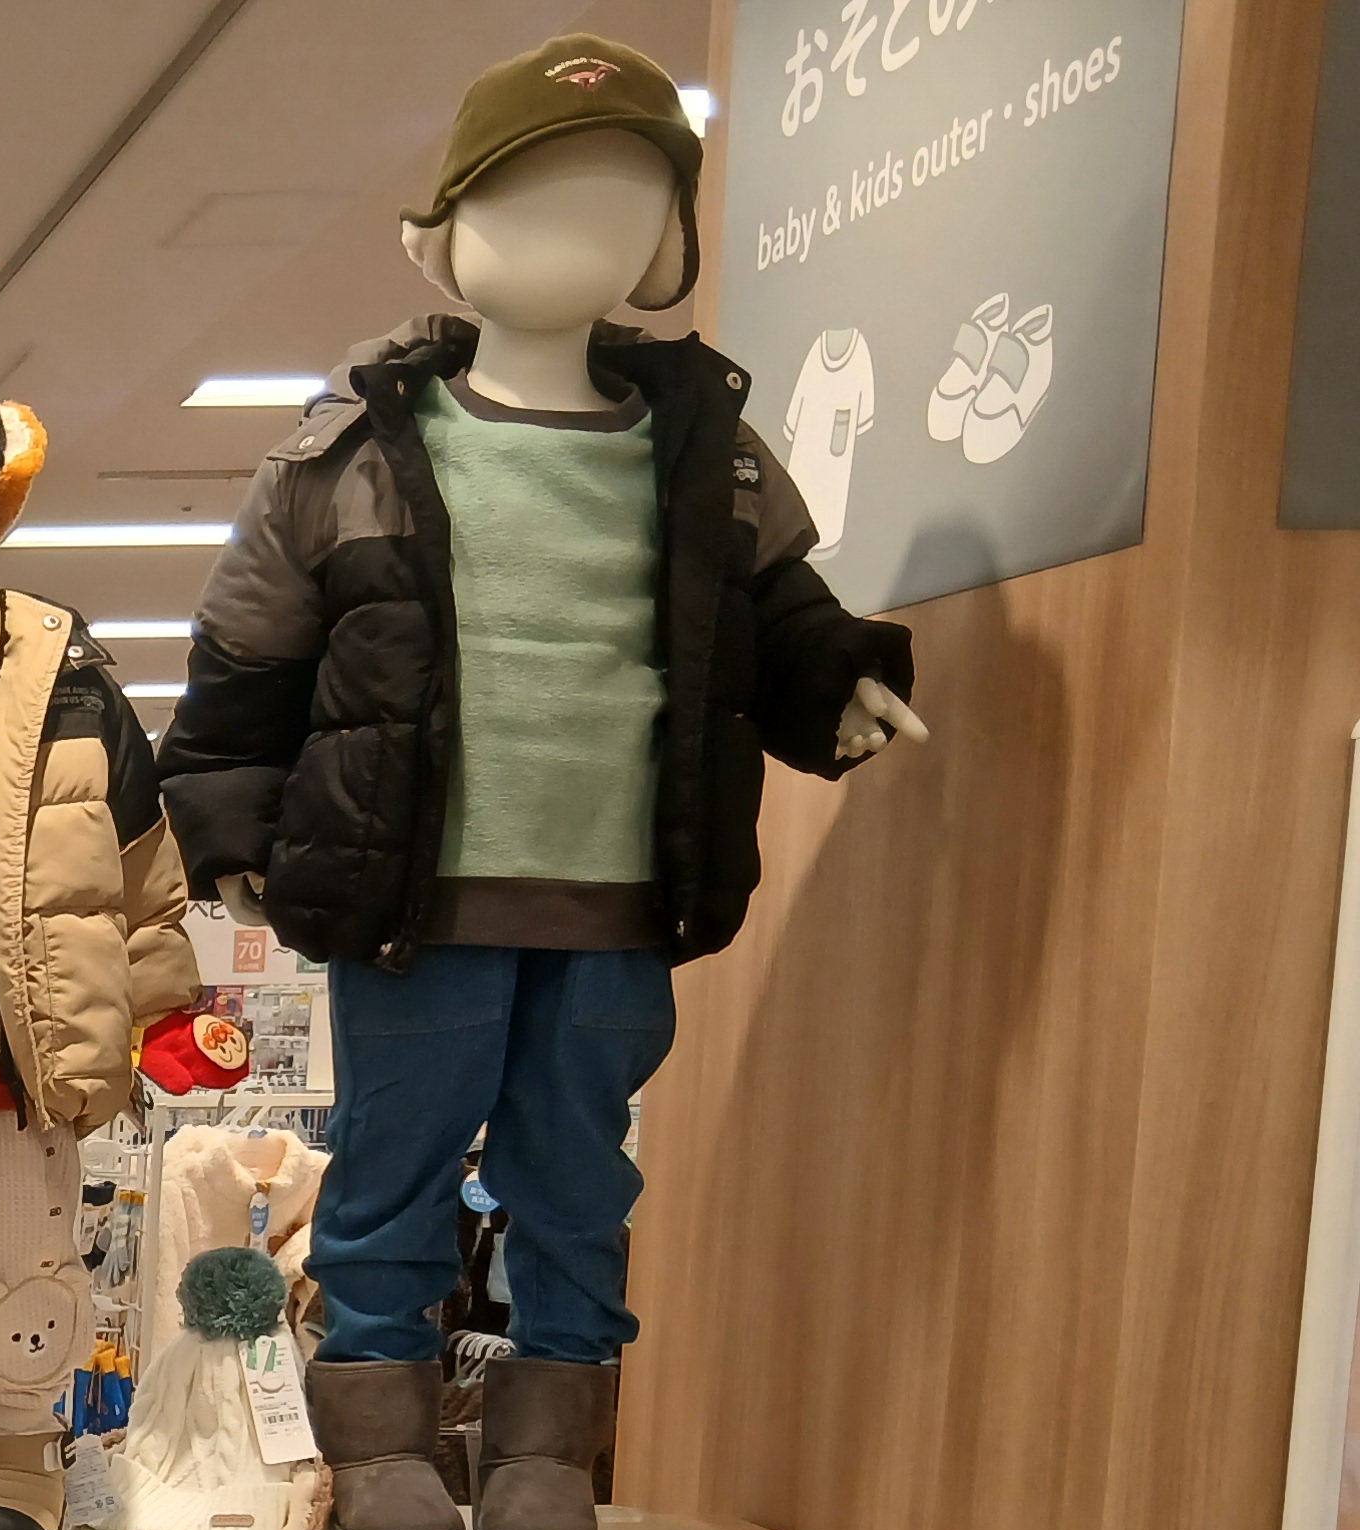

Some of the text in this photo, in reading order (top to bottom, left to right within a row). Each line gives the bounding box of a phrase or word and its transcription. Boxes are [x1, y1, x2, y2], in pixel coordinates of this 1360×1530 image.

[757, 35, 1122, 271] baby & kids outer shoes
[237, 941, 262, 960] 70
